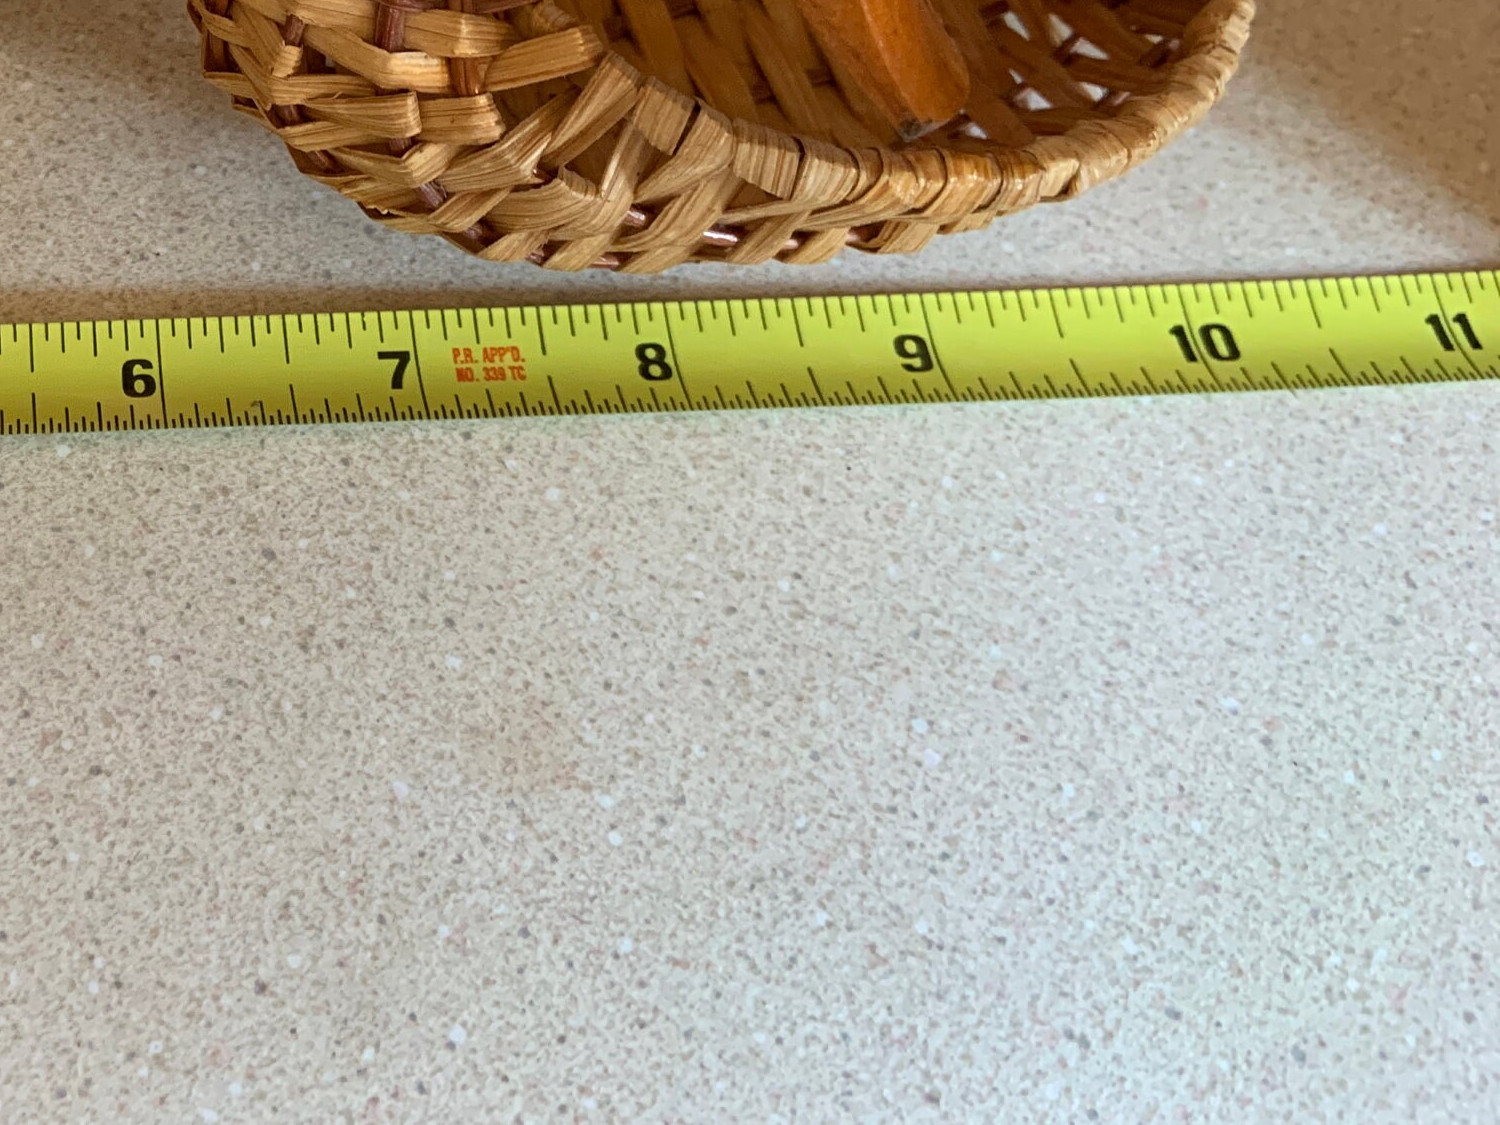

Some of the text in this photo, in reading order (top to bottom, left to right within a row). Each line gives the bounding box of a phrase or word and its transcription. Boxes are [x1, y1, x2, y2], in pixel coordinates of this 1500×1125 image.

[1168, 322, 1242, 363] 10
[1424, 311, 1484, 352] 11
[377, 350, 412, 391] 7
[635, 342, 675, 383] 8
[891, 333, 935, 374] 9
[120, 357, 157, 398] 6
[455, 366, 480, 383] NO.
